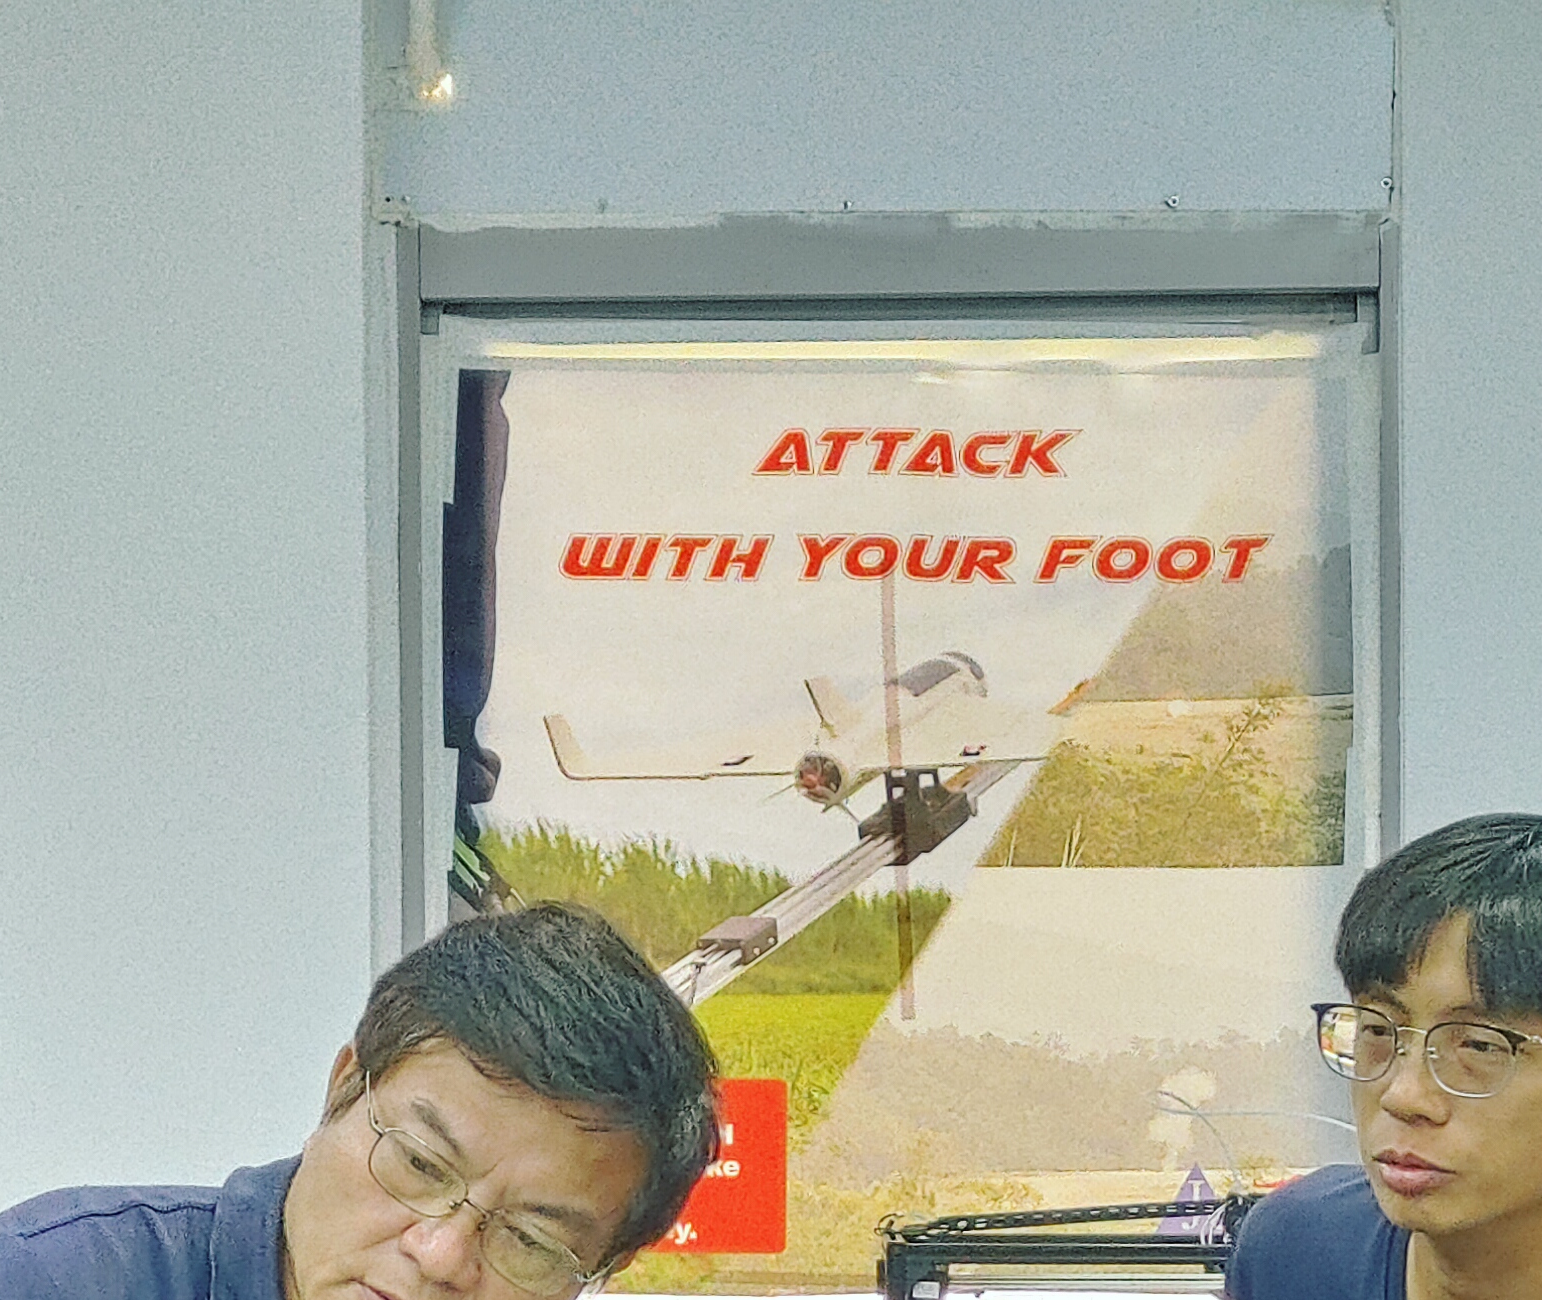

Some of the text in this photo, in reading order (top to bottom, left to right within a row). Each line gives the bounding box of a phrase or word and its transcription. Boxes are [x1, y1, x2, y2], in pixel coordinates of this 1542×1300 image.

[752, 427, 1080, 478] ATTACK
[558, 533, 1271, 584] WITH YOUR FOOT
